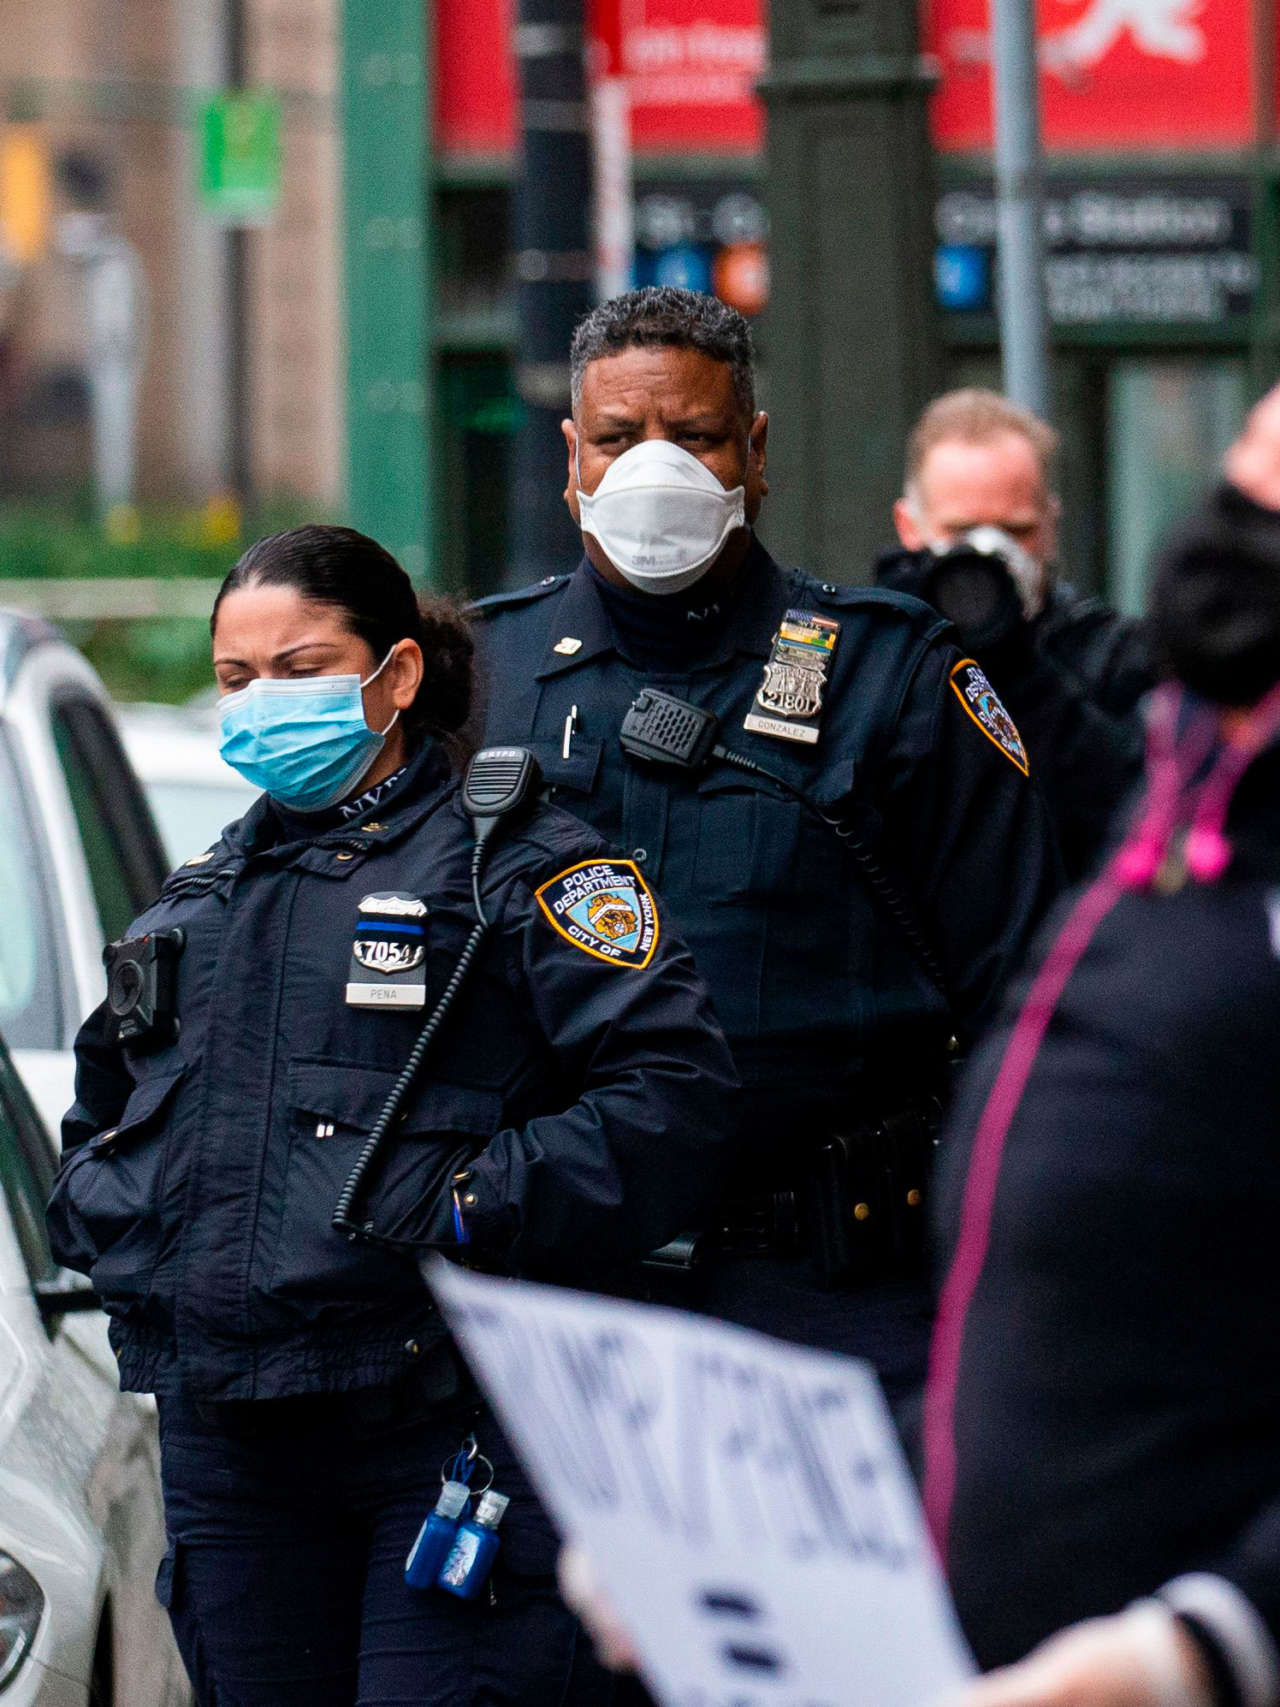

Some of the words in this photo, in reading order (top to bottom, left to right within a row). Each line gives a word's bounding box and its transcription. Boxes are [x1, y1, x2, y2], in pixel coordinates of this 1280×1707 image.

[766, 691, 812, 713] 21801
[757, 718, 807, 738] GONZALEZ
[562, 865, 615, 892] POLICE
[553, 875, 636, 915] DEPARTMENT
[638, 893, 655, 926] YORK
[567, 924, 599, 946] CITY
[599, 944, 622, 958] OF
[639, 926, 655, 952] NEW
[369, 988, 398, 1001] PENA
